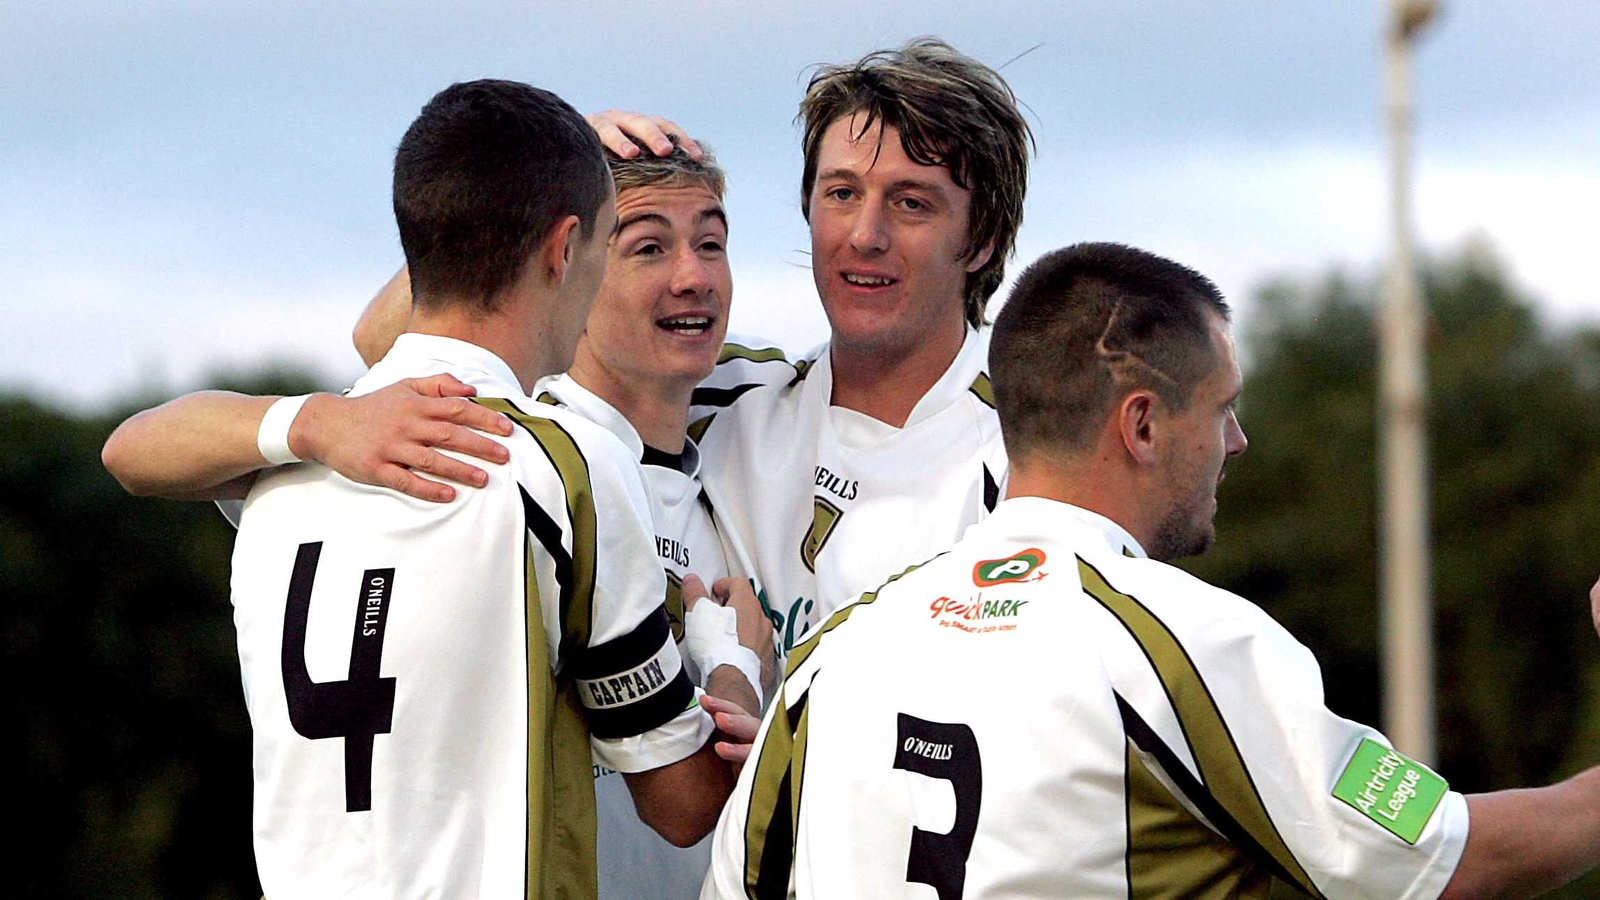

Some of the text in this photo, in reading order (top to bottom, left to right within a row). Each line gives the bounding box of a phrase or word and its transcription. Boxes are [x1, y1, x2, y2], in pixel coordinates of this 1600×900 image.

[362, 577, 385, 637] O'NEILLS
[281, 541, 397, 812] 4
[588, 658, 667, 706] CAPTAIN
[903, 737, 953, 760] O'NEILLS
[893, 712, 983, 900] 3
[1354, 750, 1406, 814] Airtricity
[1377, 769, 1421, 822] League
